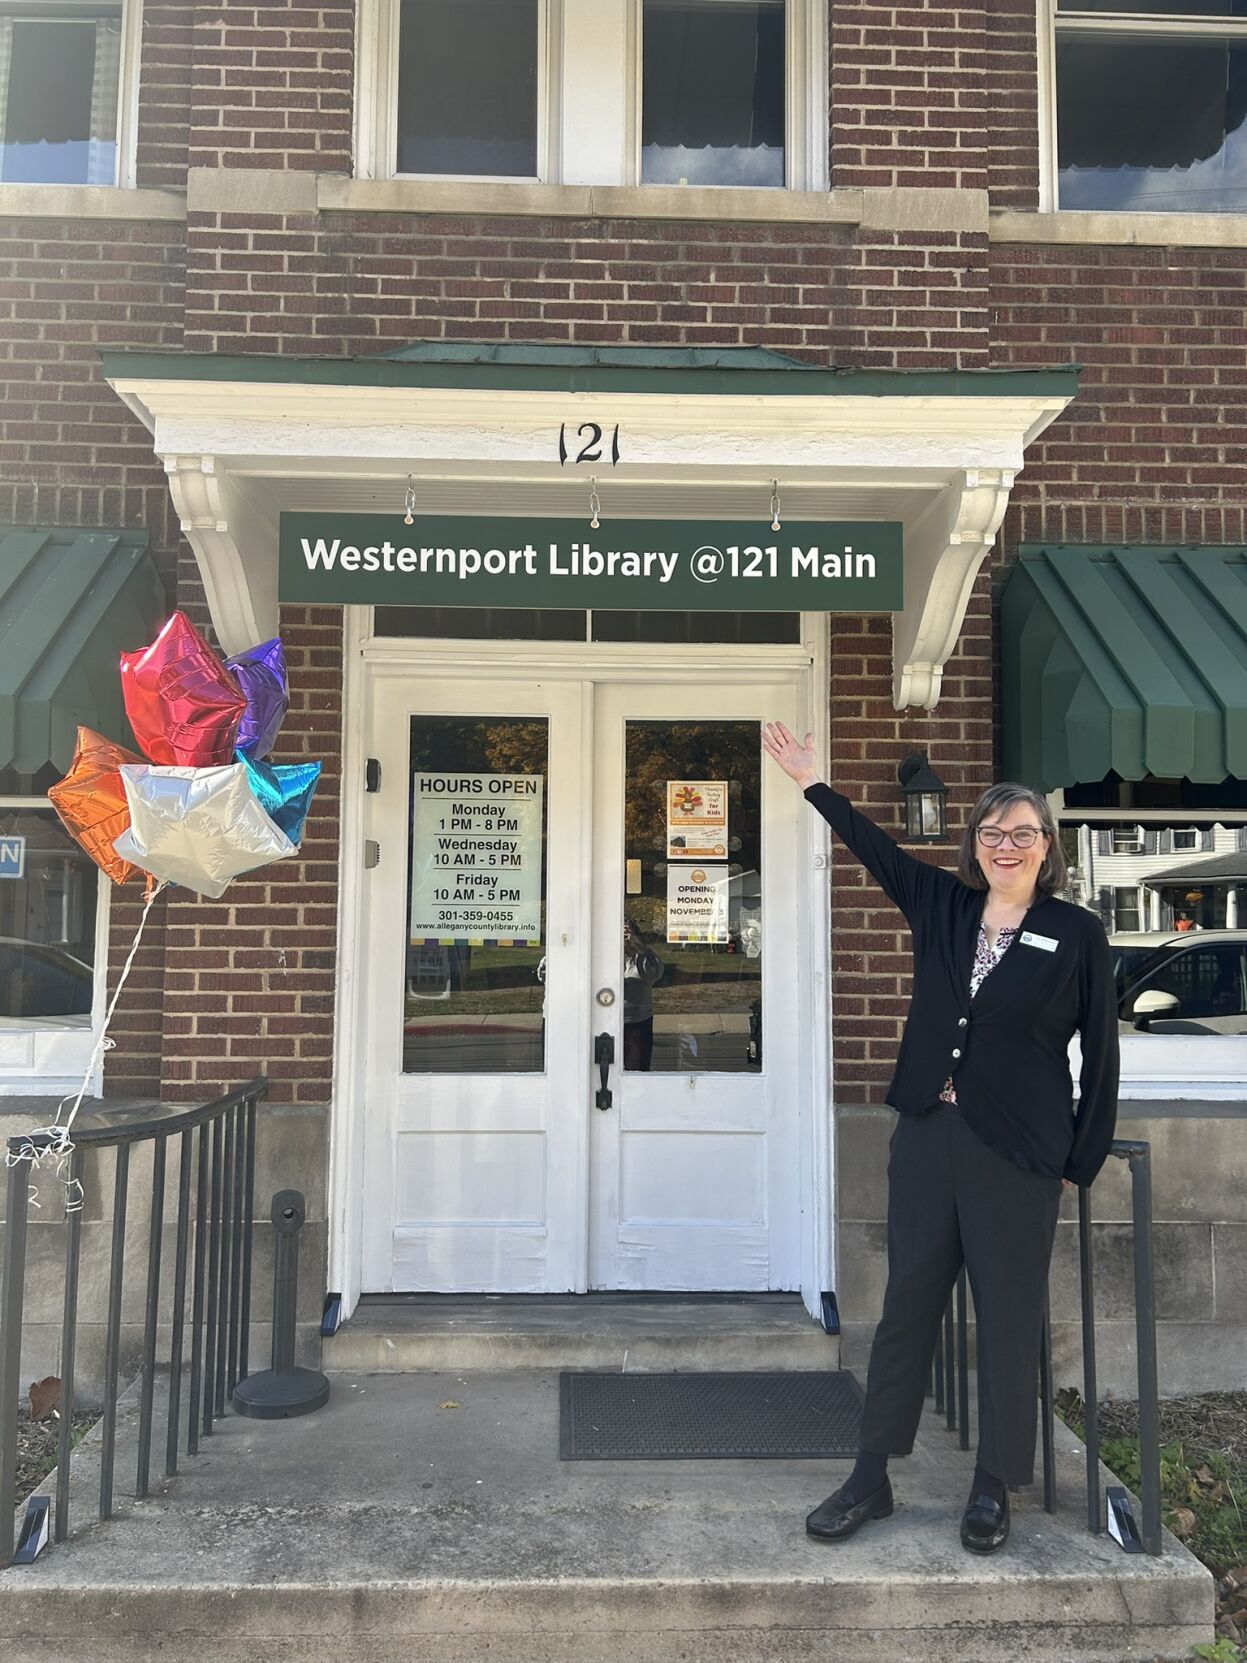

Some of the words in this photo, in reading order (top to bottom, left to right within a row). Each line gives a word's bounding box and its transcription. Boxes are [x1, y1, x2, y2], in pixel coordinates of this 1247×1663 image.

[559, 422, 620, 466] 121
[300, 538, 537, 580] Westernport
[549, 543, 679, 583] Library
[690, 545, 778, 583] @121
[791, 546, 876, 578] Main
[420, 778, 483, 793] HOURS
[488, 779, 537, 794] OPEN
[452, 803, 506, 818] Monday
[439, 818, 445, 830] 1
[451, 818, 472, 830] PM
[485, 819, 493, 830] 8
[497, 819, 518, 830] PM
[438, 838, 518, 853] Wednesday
[433, 853, 450, 865] 10
[453, 853, 476, 865] AM
[488, 854, 497, 865] 5
[500, 854, 522, 866] PM
[456, 873, 499, 888] Friday
[433, 888, 449, 900] 10
[452, 888, 475, 900] AM
[487, 889, 496, 901] 5
[499, 889, 520, 901] PM
[678, 885, 716, 893] OPENING
[438, 910, 514, 922] 301-359-0455
[670, 908, 713, 916] NOVEMBE
[415, 922, 536, 932] www.alleganycountylibrary.info
